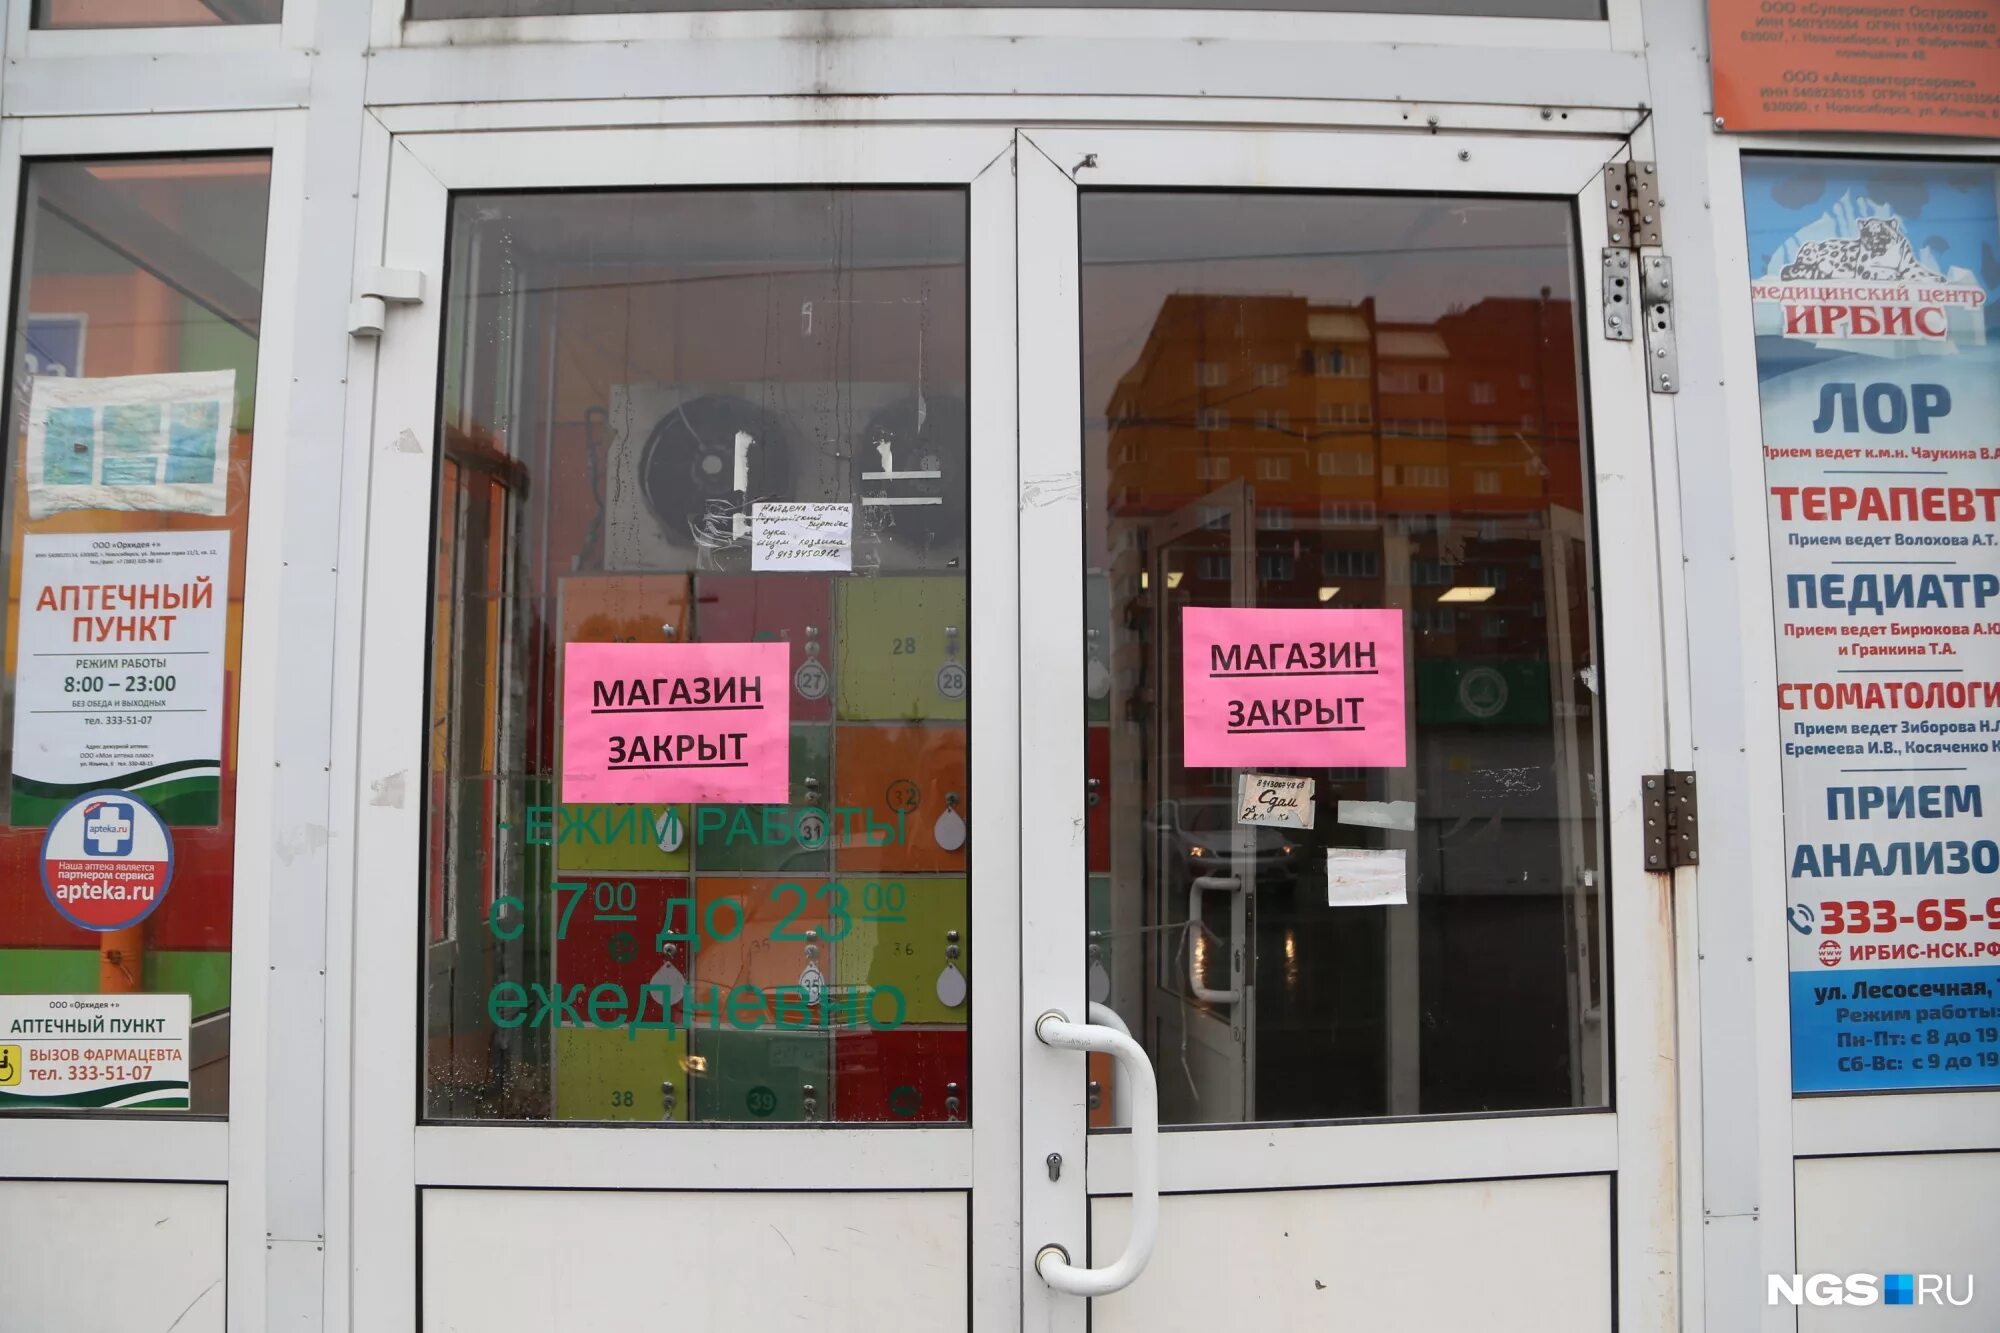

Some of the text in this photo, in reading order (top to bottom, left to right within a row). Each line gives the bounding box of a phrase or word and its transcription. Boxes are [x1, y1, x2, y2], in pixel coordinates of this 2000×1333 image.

[1784, 304, 1947, 338] ИРБИС
[1812, 382, 1953, 435] ЛОР
[1815, 447, 1862, 460] ведет
[1911, 446, 1977, 462] Чаукина
[1771, 487, 2000, 522] ТЕРАПЕВТ
[1788, 533, 1841, 548] Прием
[1845, 535, 1891, 547] ведет
[1894, 533, 1969, 546] Волохова
[36, 576, 213, 611] АПТЕЧНЫЙ
[1786, 574, 2000, 616] ПЕДИАТР
[72, 615, 177, 642] ПУНКТ
[1784, 623, 1837, 639] Прием
[1840, 625, 1887, 637] ведет
[1890, 622, 1969, 638] Бирюкова
[893, 638, 915, 655] 28
[1210, 641, 1376, 671] МАГАЗИН
[1838, 643, 1957, 658] и Гранкина Т.А.
[76, 658, 167, 669] РЕЖИМ РАБОТЫ
[64, 676, 104, 693] 8:00
[125, 675, 176, 692] 23:00
[592, 676, 762, 707] МАГАЗИН
[802, 674, 822, 690] 27
[84, 715, 153, 725] тел. 333-51-07
[1227, 698, 1365, 727] ЗАКРЫТ
[1794, 722, 1848, 737] Прием
[1851, 723, 1898, 735] ведет
[1901, 720, 1976, 736] Зиборова
[608, 733, 748, 763] ЗАКРЫТ
[1785, 743, 1864, 758] Еремеева
[1905, 740, 1989, 754] Косяченко
[1258, 789, 1298, 813] Сдам
[1827, 785, 1983, 820] ПРИЕМ
[499, 805, 906, 847] ЕЖИМ РАБОТЫ
[58, 862, 154, 872] Наша аптека является
[1791, 840, 2000, 878] АНАЛИЗО
[57, 872, 154, 881] партнером сервиса
[56, 880, 154, 903] apteka.ru
[656, 895, 744, 953] до
[1850, 941, 2000, 961] ИРБИС-НСК.РФ
[1814, 982, 1993, 1005] ул. Лесосечная,
[487, 981, 906, 1041] ежедневно
[1836, 1007, 1911, 1023] Режим
[10, 1015, 166, 1033] АПТЕЧНЫЙ ПУНКТ
[1837, 1028, 1998, 1048] Пн-Пт: с 8 до 19
[30, 1048, 182, 1063] ВЫЗОВ ФАРМАЦЕВТА
[1838, 1052, 1999, 1072] Сб-Вс: с 9 до 19
[29, 1066, 153, 1080] тел. 333-51-07
[611, 1091, 634, 1107] 38
